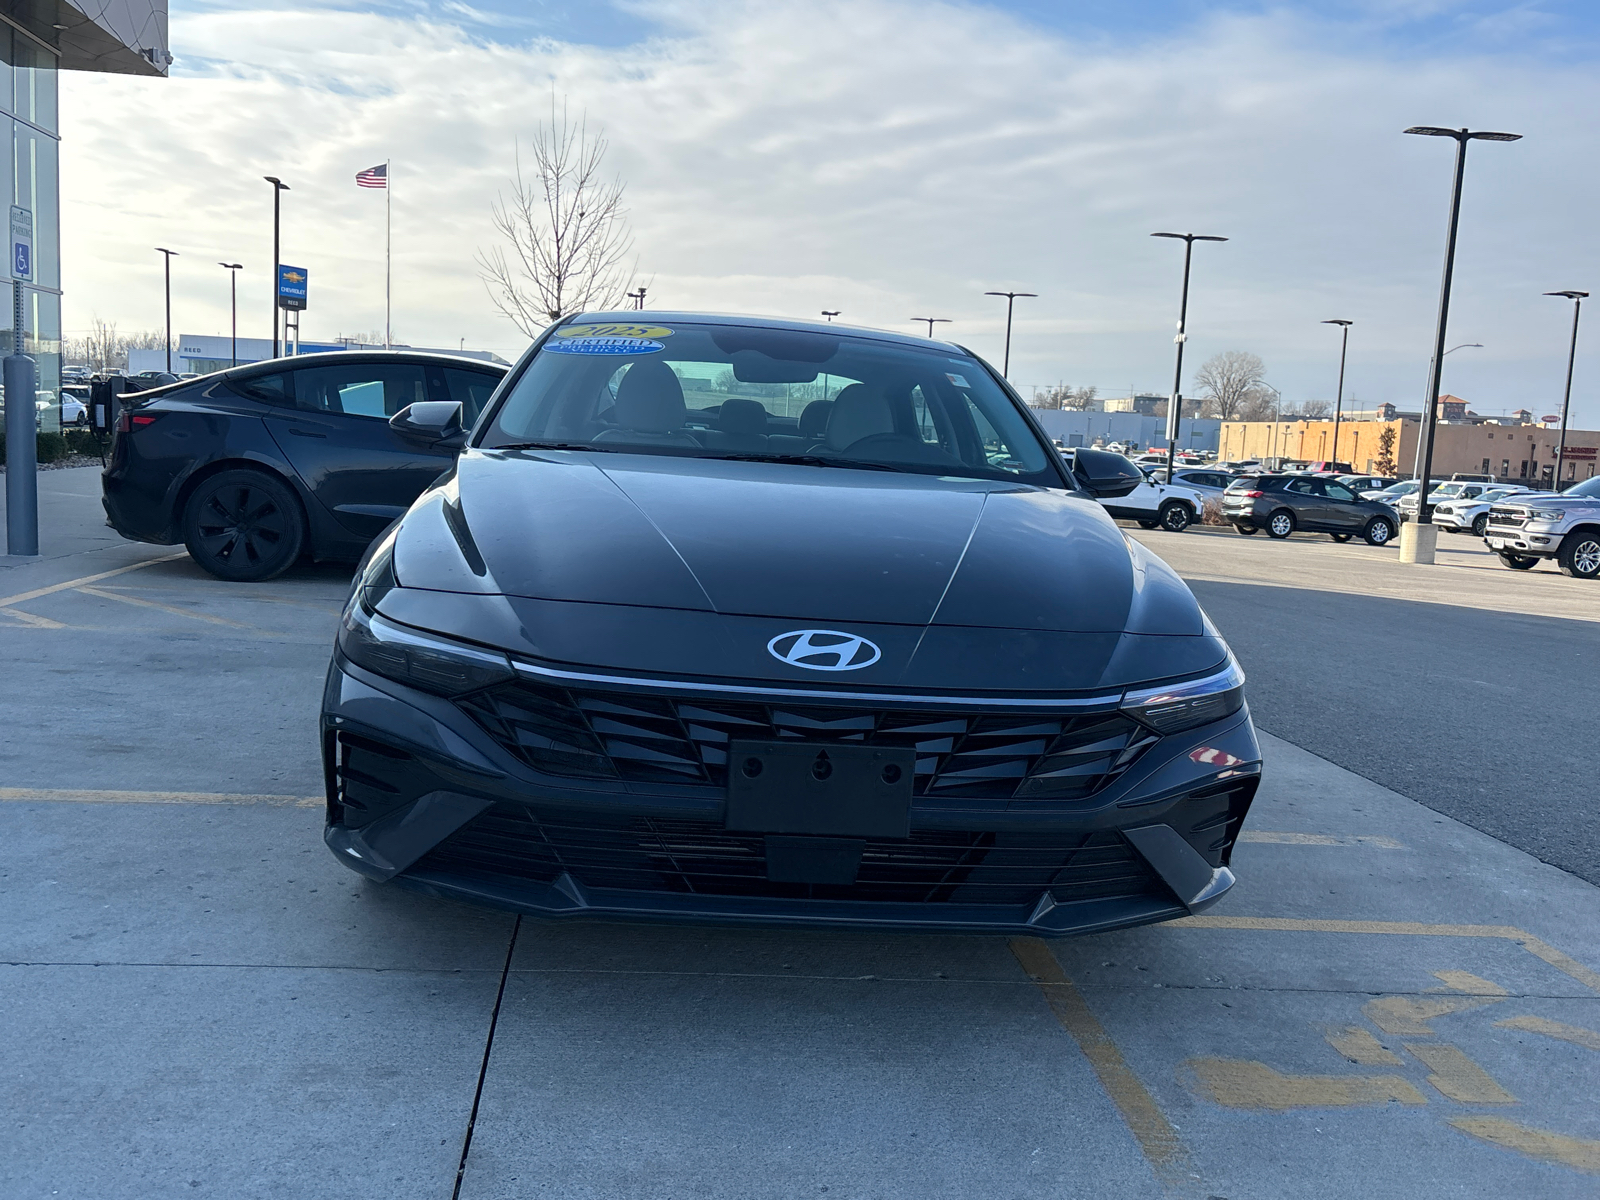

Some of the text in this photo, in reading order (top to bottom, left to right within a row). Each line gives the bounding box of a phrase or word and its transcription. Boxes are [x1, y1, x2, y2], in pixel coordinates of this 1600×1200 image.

[12, 224, 31, 239] PARKING
[280, 286, 305, 295] CHEVROLET
[570, 326, 655, 336] 2025
[558, 338, 654, 346] CERTIFIED
